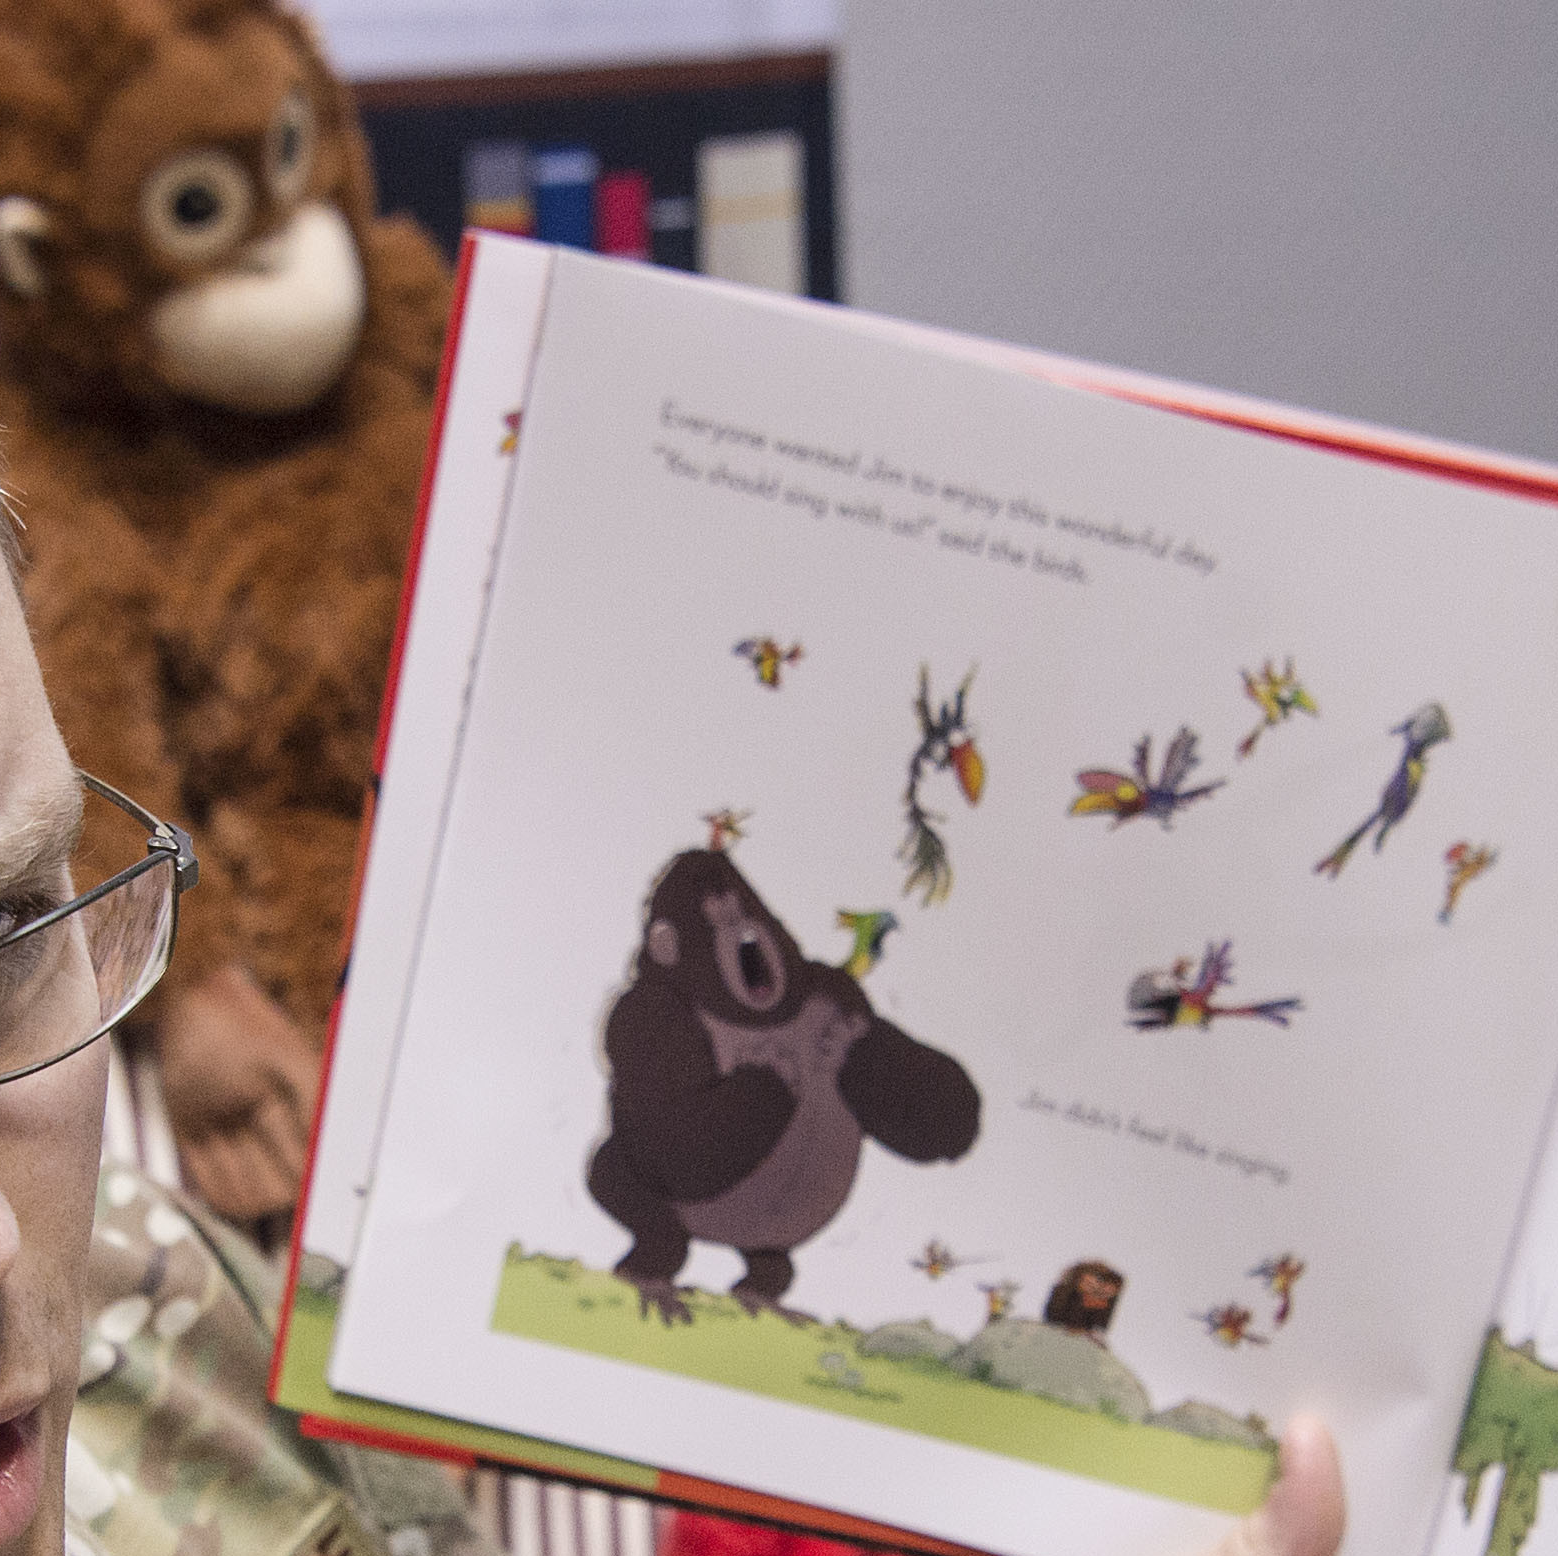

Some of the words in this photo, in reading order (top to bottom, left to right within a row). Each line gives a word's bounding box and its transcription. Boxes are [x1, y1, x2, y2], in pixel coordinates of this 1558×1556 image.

[659, 398, 767, 448] Everyone
[773, 440, 861, 476] wanted
[862, 456, 907, 487] Jim
[910, 470, 937, 497] to
[940, 482, 1001, 519] enjoy
[1007, 496, 1050, 529] this
[1054, 513, 1173, 560] wonderful
[706, 460, 782, 501] should
[784, 483, 829, 521] sing
[835, 499, 885, 528] with
[939, 527, 987, 556] said
[988, 538, 1026, 569] the
